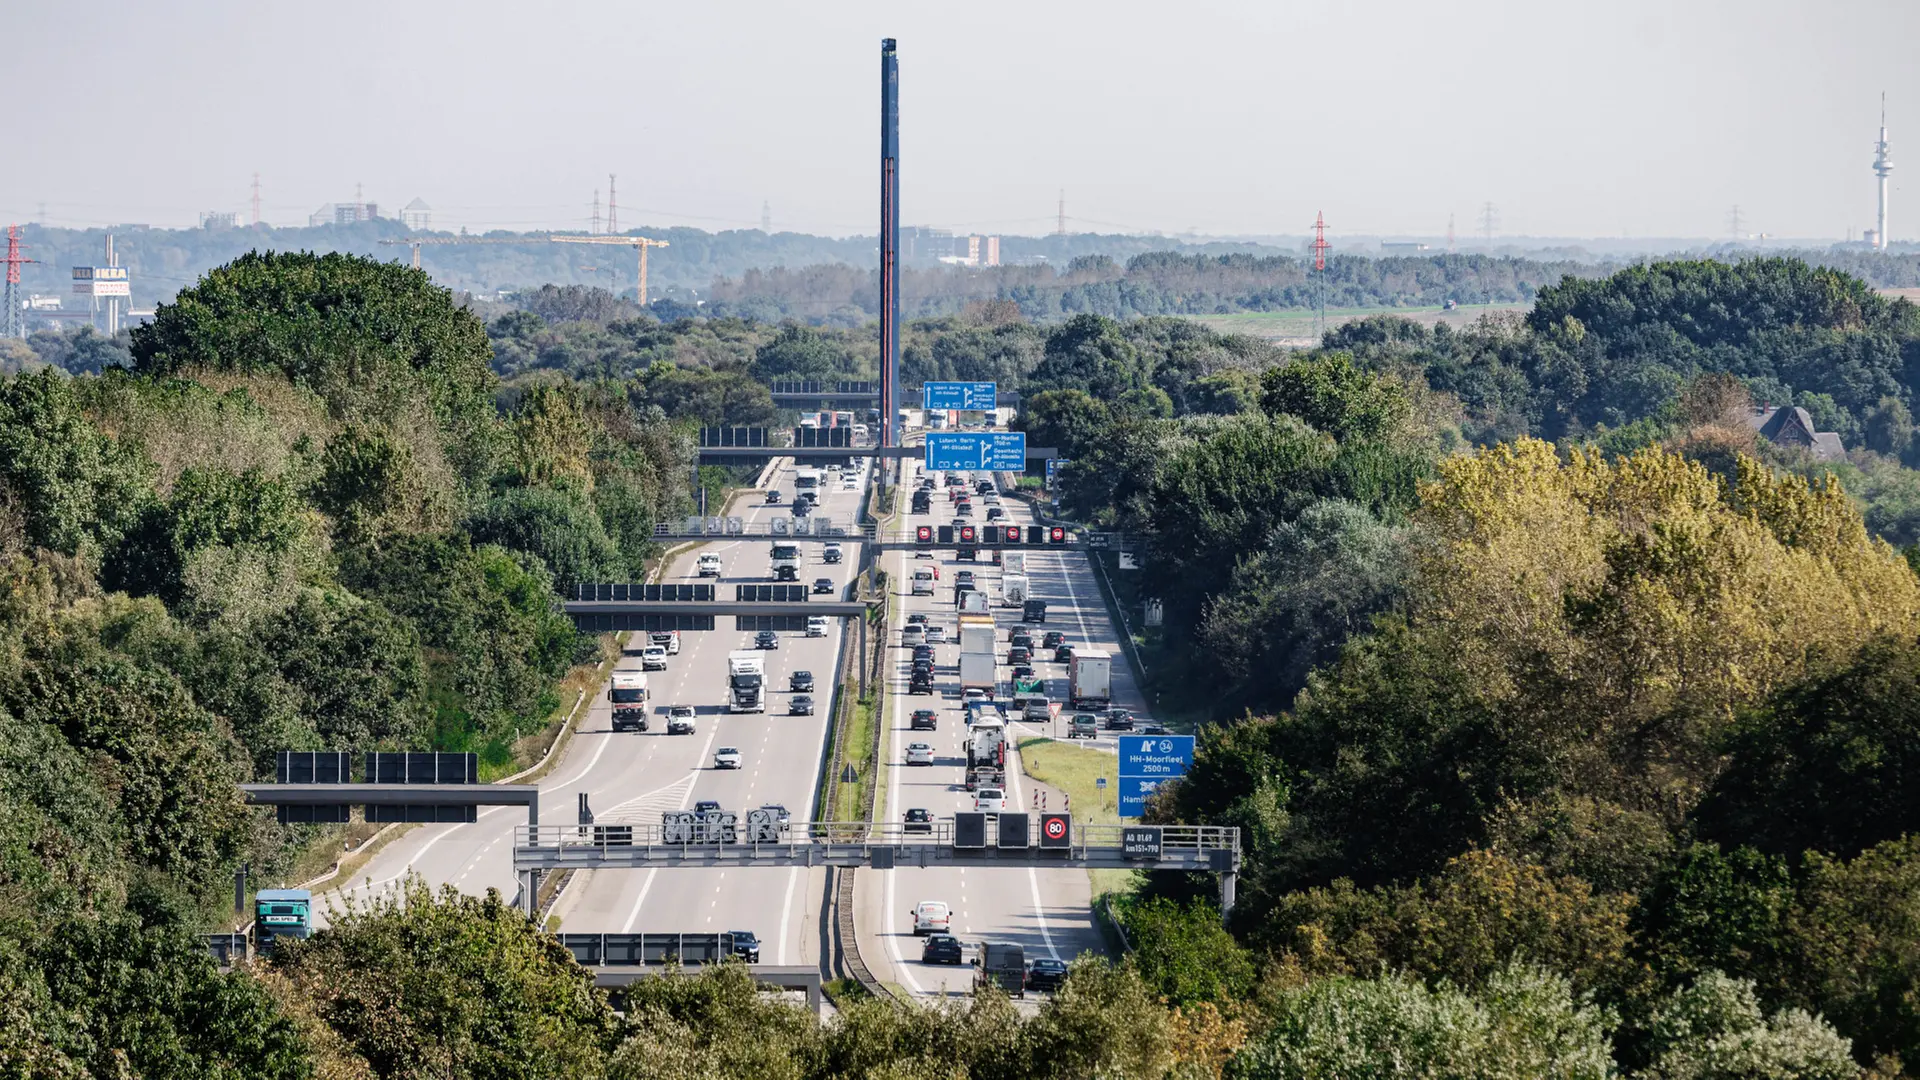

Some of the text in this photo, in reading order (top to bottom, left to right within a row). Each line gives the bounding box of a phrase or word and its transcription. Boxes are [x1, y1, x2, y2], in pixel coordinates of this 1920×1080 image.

[95, 268, 127, 279] IKEA
[1162, 742, 1171, 750] 34
[1129, 755, 1183, 763] HH-Moorfleet
[1049, 823, 1062, 833] 80
